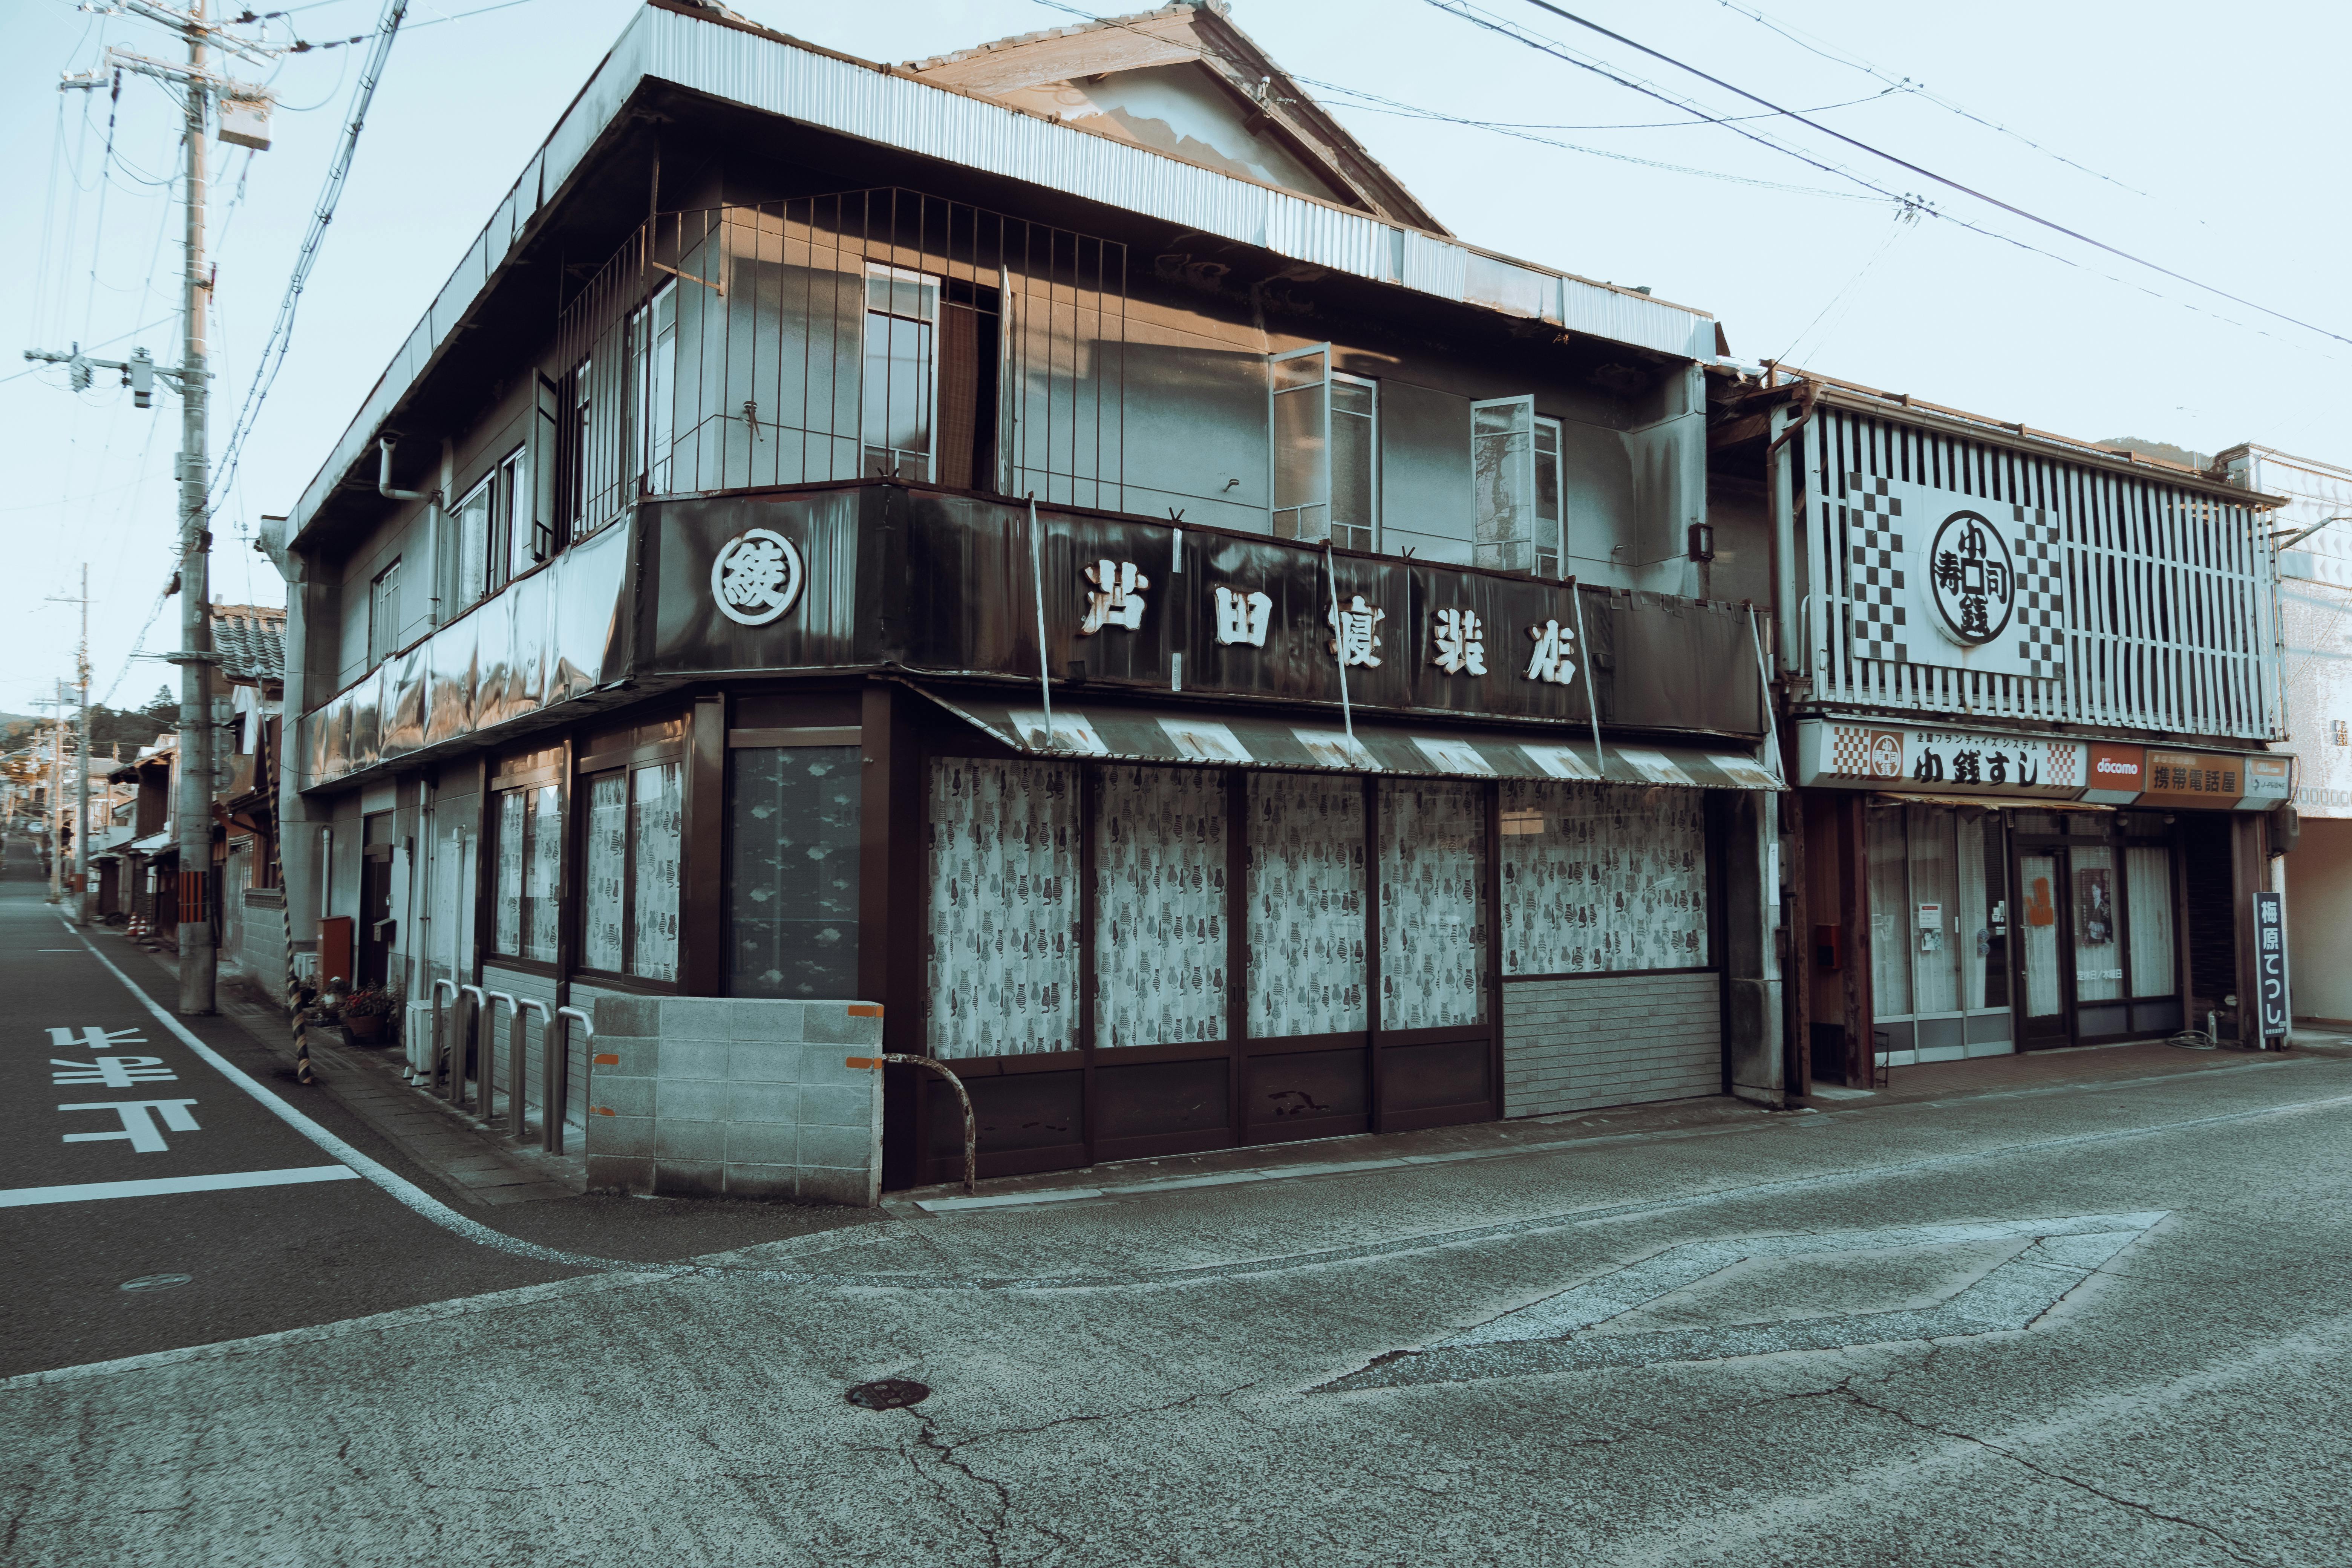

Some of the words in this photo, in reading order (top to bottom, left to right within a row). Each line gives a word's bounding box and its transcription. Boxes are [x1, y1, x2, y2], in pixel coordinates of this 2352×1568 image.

[2097, 758, 2138, 775] docomo
[2154, 766, 2235, 793] 携帯電話屋
[2262, 901, 2281, 1024] 梅原てつし
[44, 1026, 201, 1153] 止まれ
